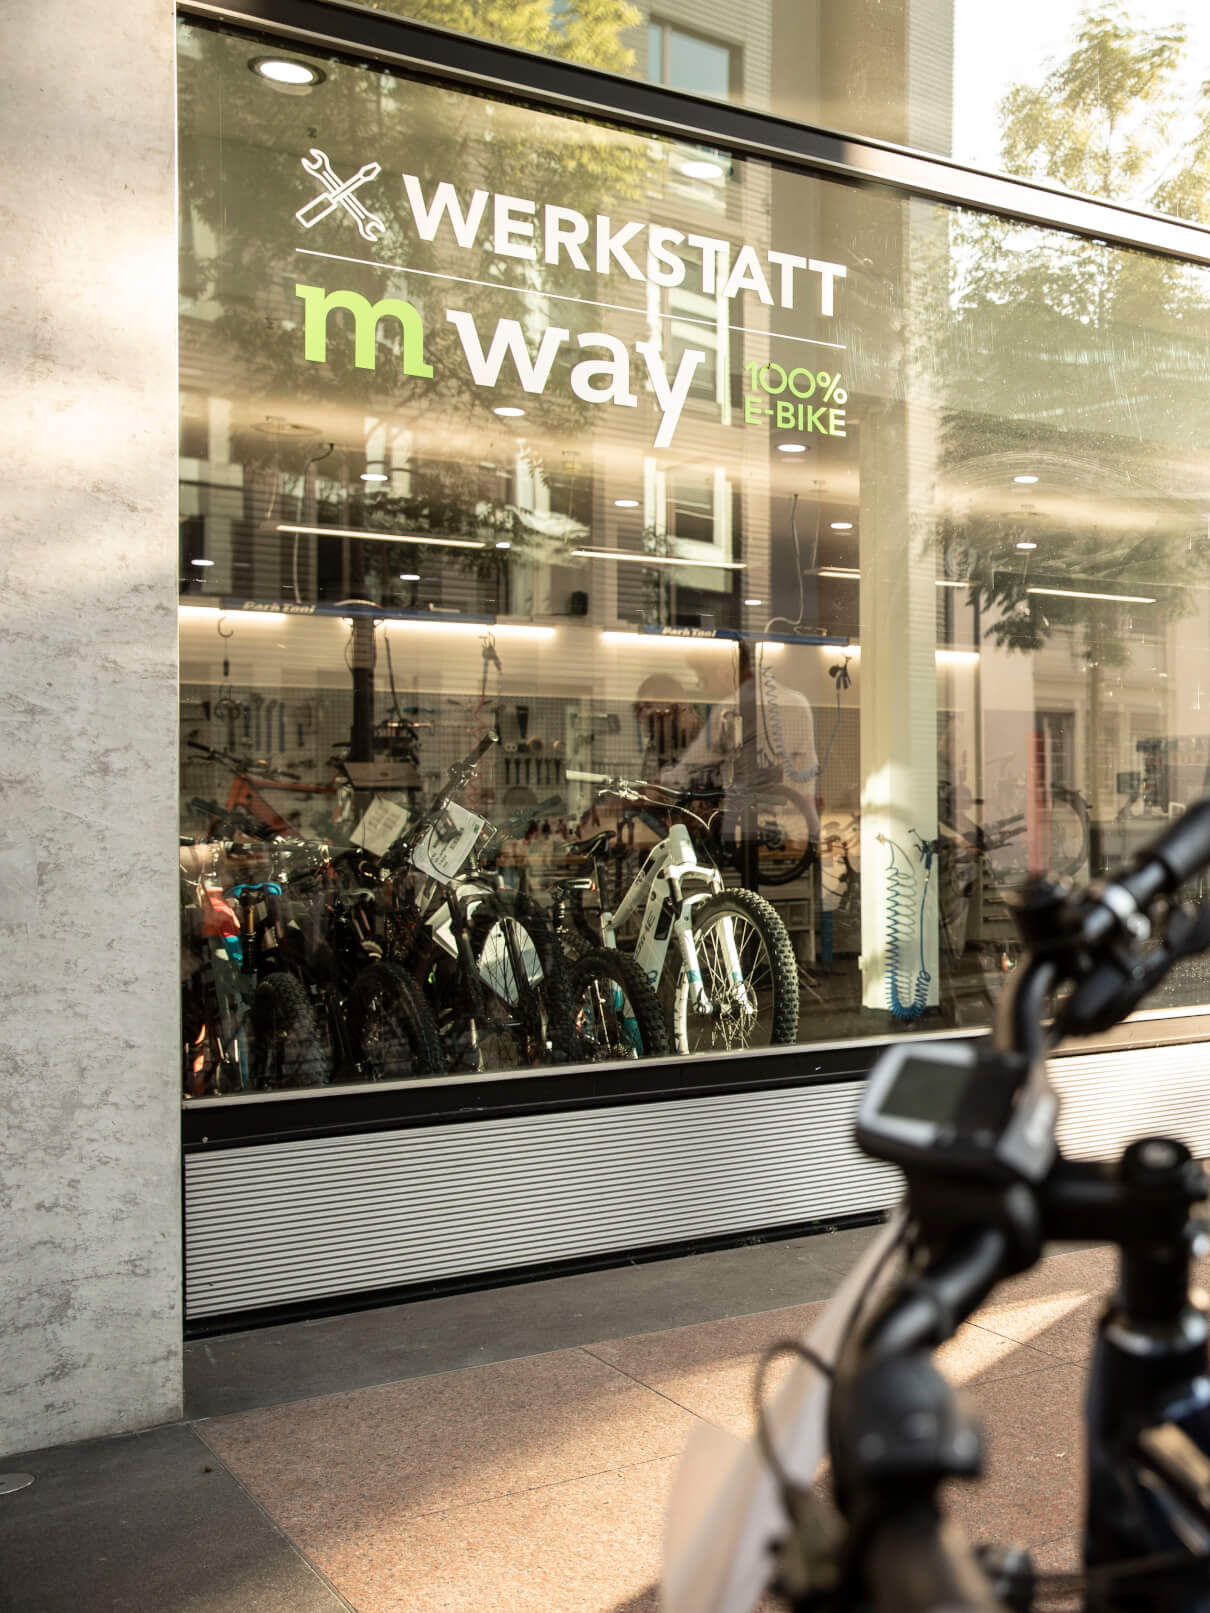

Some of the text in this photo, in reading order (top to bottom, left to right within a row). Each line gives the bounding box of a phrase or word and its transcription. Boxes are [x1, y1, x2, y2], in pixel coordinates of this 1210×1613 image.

[402, 173, 847, 317] WERKSTATT
[744, 361, 848, 405] 100%
[744, 396, 847, 437] E-BIKE
